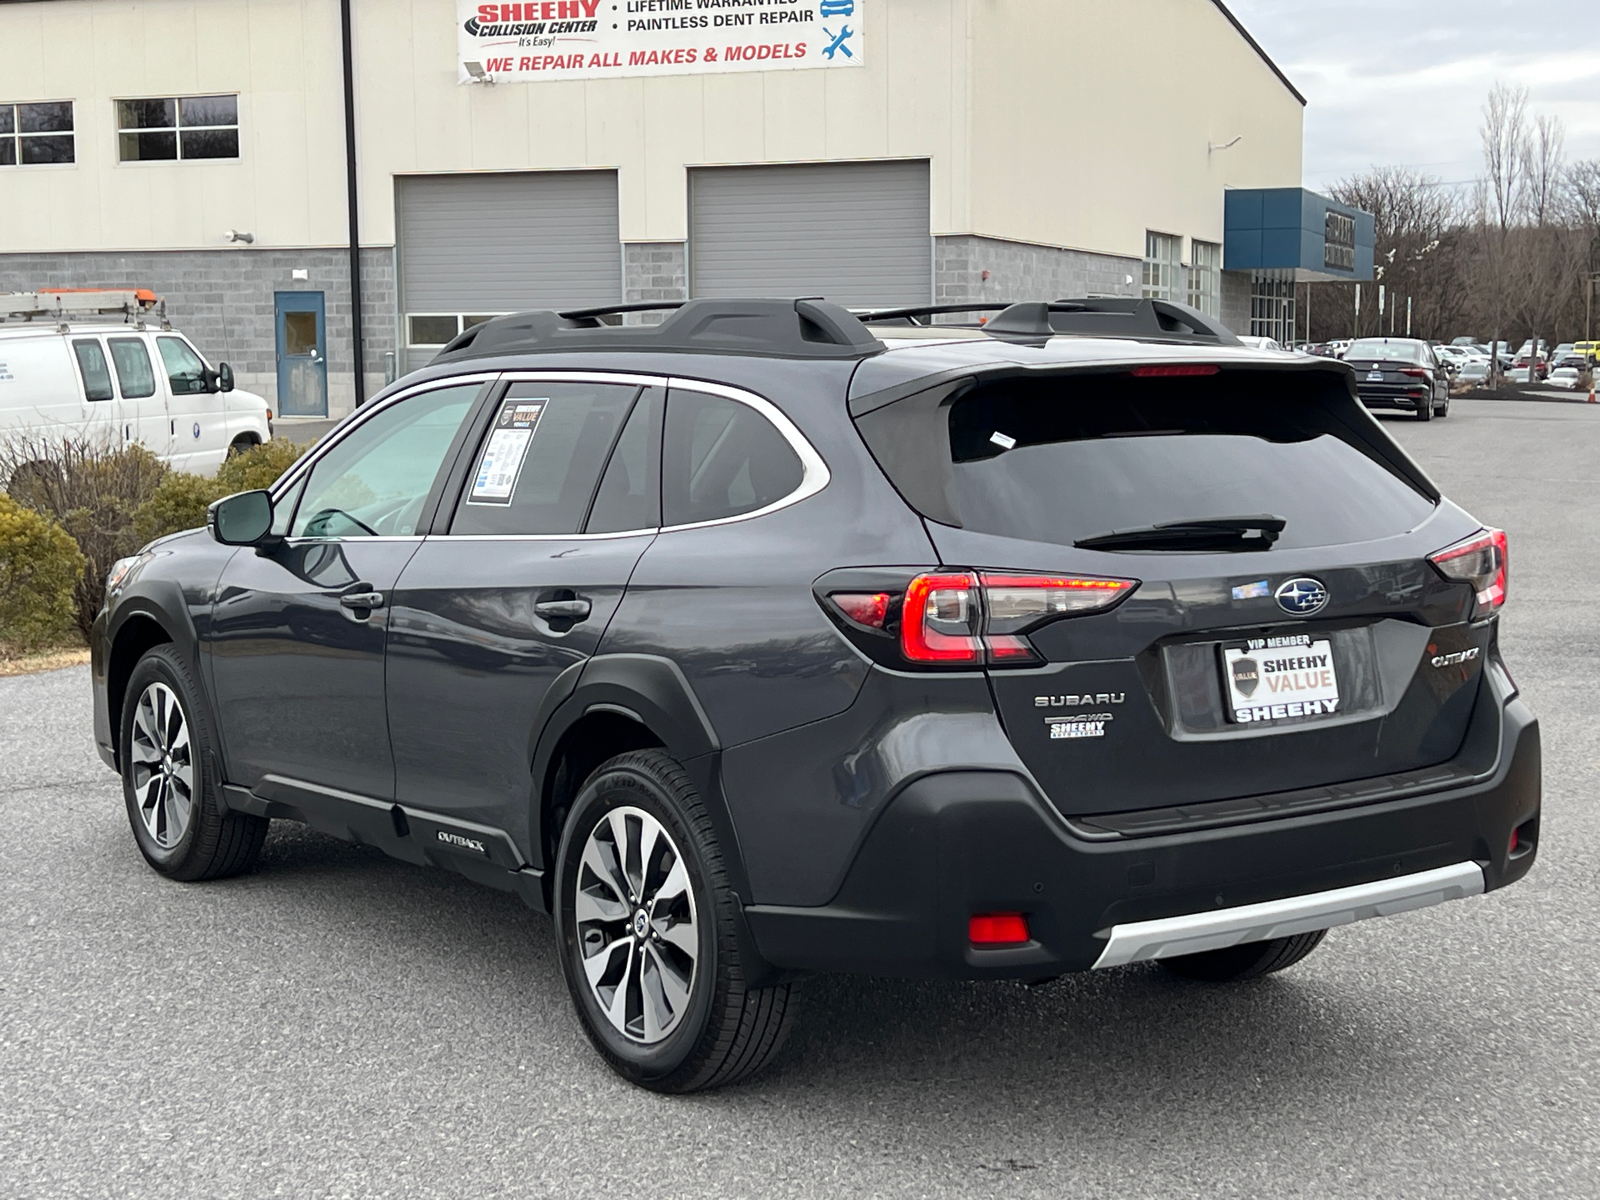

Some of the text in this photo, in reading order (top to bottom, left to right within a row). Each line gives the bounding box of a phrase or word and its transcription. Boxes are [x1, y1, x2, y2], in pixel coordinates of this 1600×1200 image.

[478, 0, 600, 23] SHEEHY
[627, 0, 798, 13] LIFETIME WARRA
[479, 20, 598, 37] COLLISION CENTER
[627, 10, 814, 31] PAINTLESS DENT REPAIR
[518, 36, 556, 48] It's Easy!
[486, 42, 808, 73] WE REPAIR ALL MAKES & MODELS
[513, 411, 539, 421] VALUE
[1247, 634, 1310, 650] VIP MEMBER
[1263, 654, 1327, 673] SHEEHY
[1266, 670, 1333, 693] VALUE
[1034, 692, 1125, 707] SUBARU
[1235, 698, 1339, 723] SHEEHY
[1051, 721, 1105, 733] SHEEHY
[438, 831, 485, 852] OUTBACK
